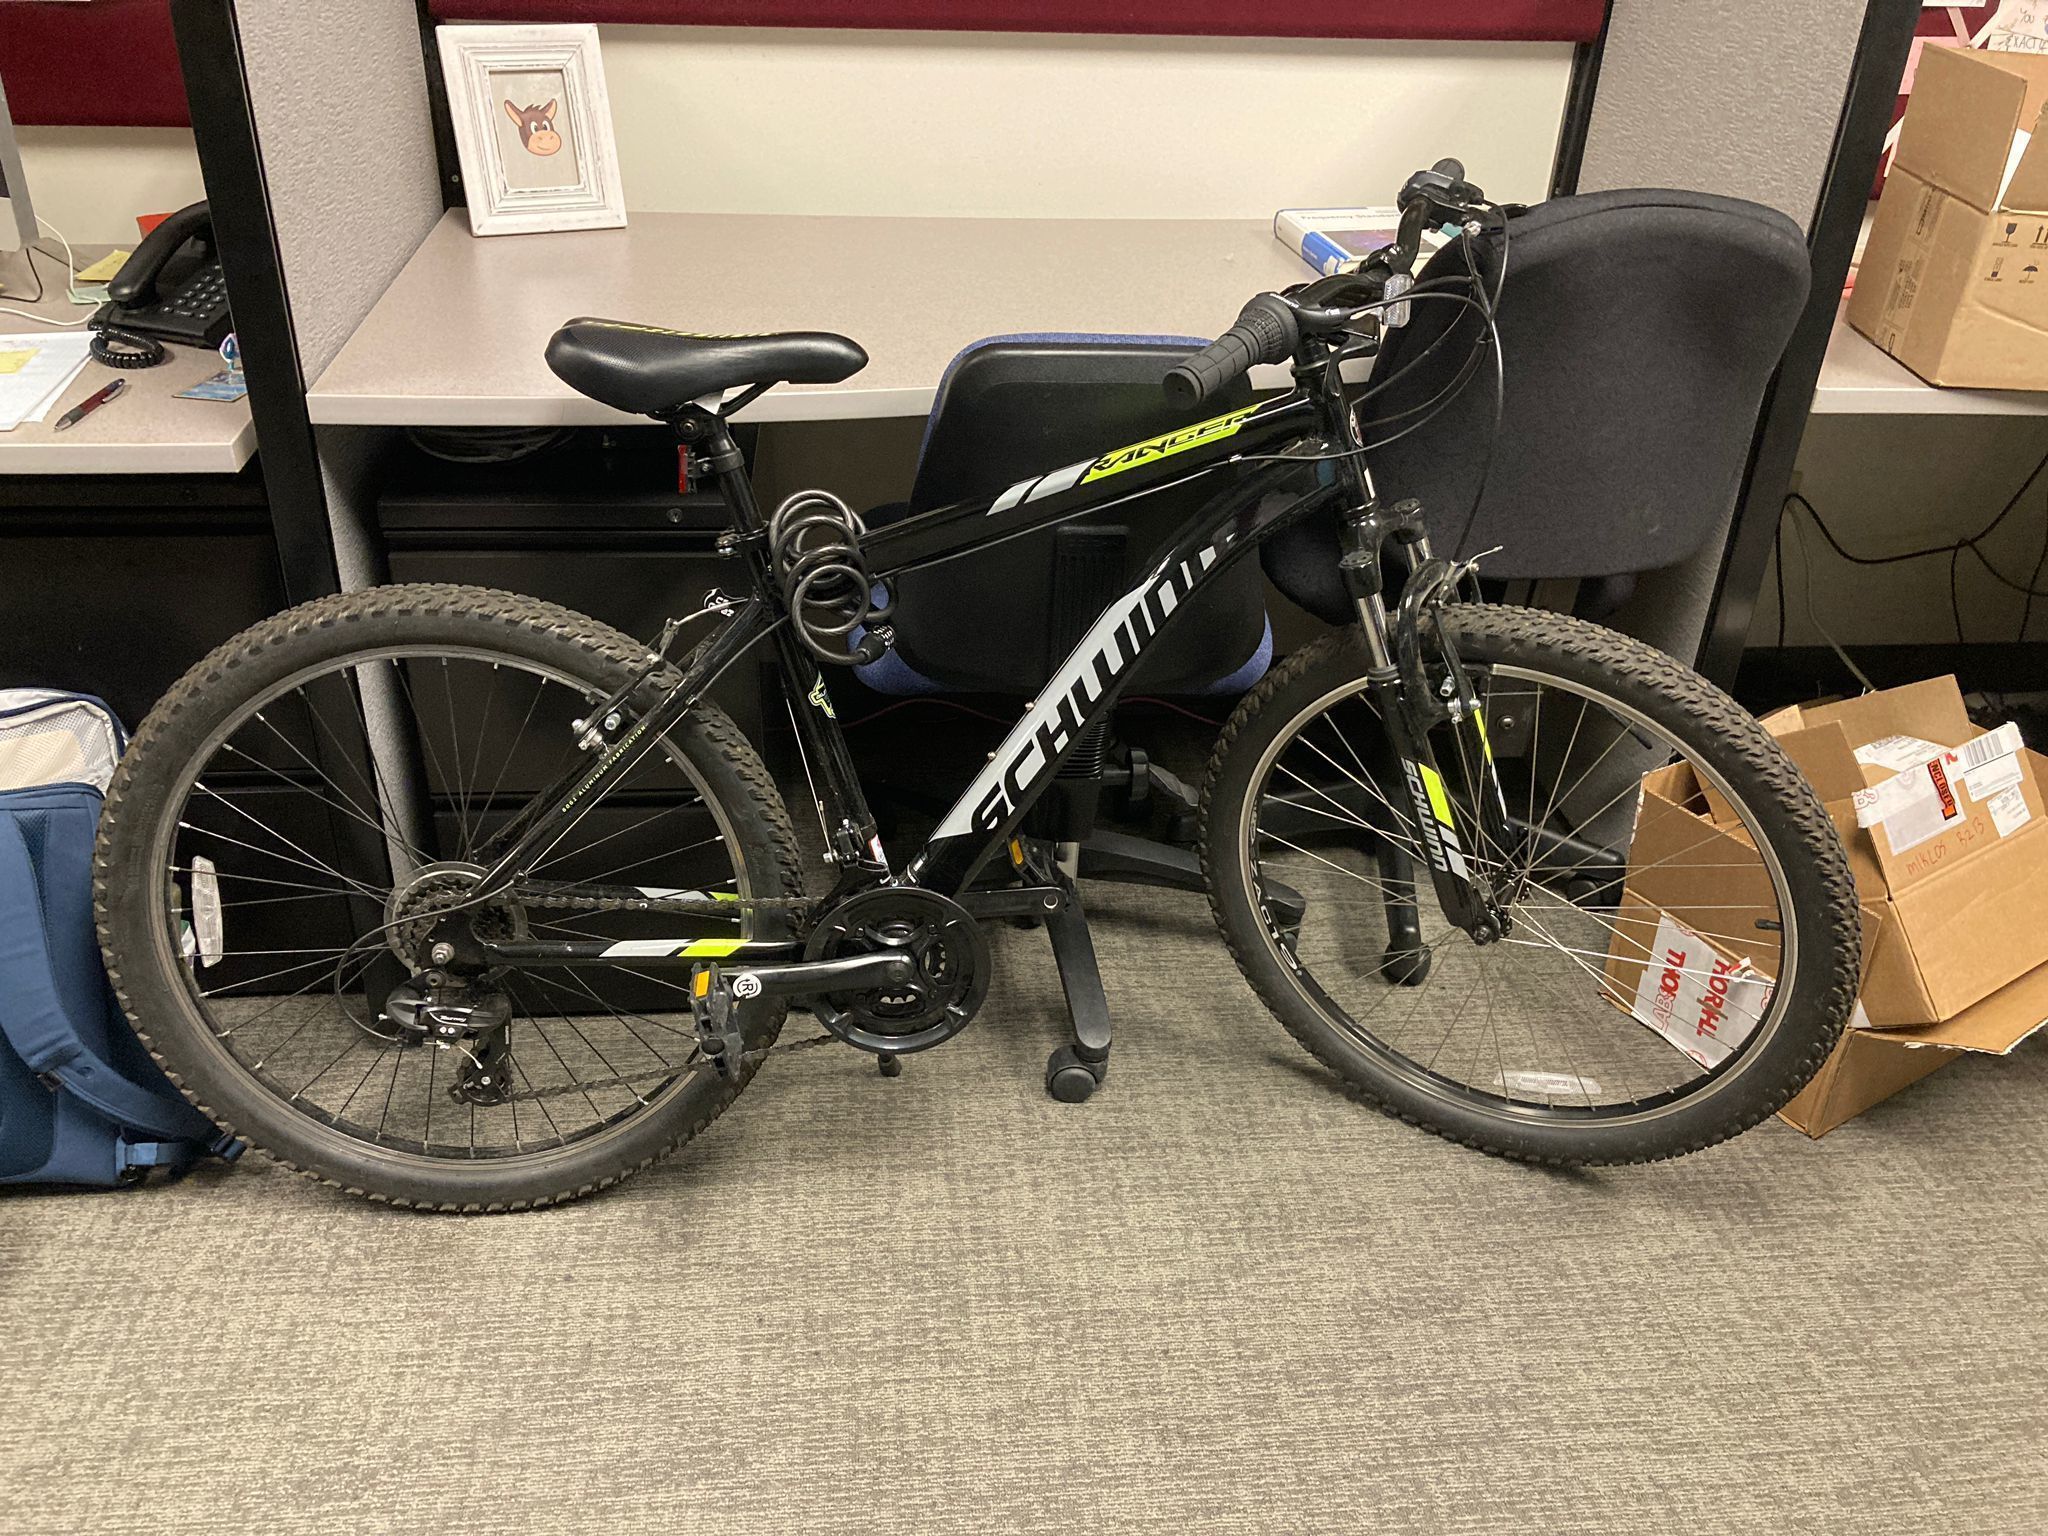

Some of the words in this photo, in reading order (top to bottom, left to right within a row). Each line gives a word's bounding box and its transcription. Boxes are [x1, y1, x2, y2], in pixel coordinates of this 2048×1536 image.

[1093, 411, 1253, 472] RANGER
[578, 764, 608, 797] ALUMINUM
[608, 725, 646, 765] FABRICATION
[1400, 756, 1448, 873] SCHWINN
